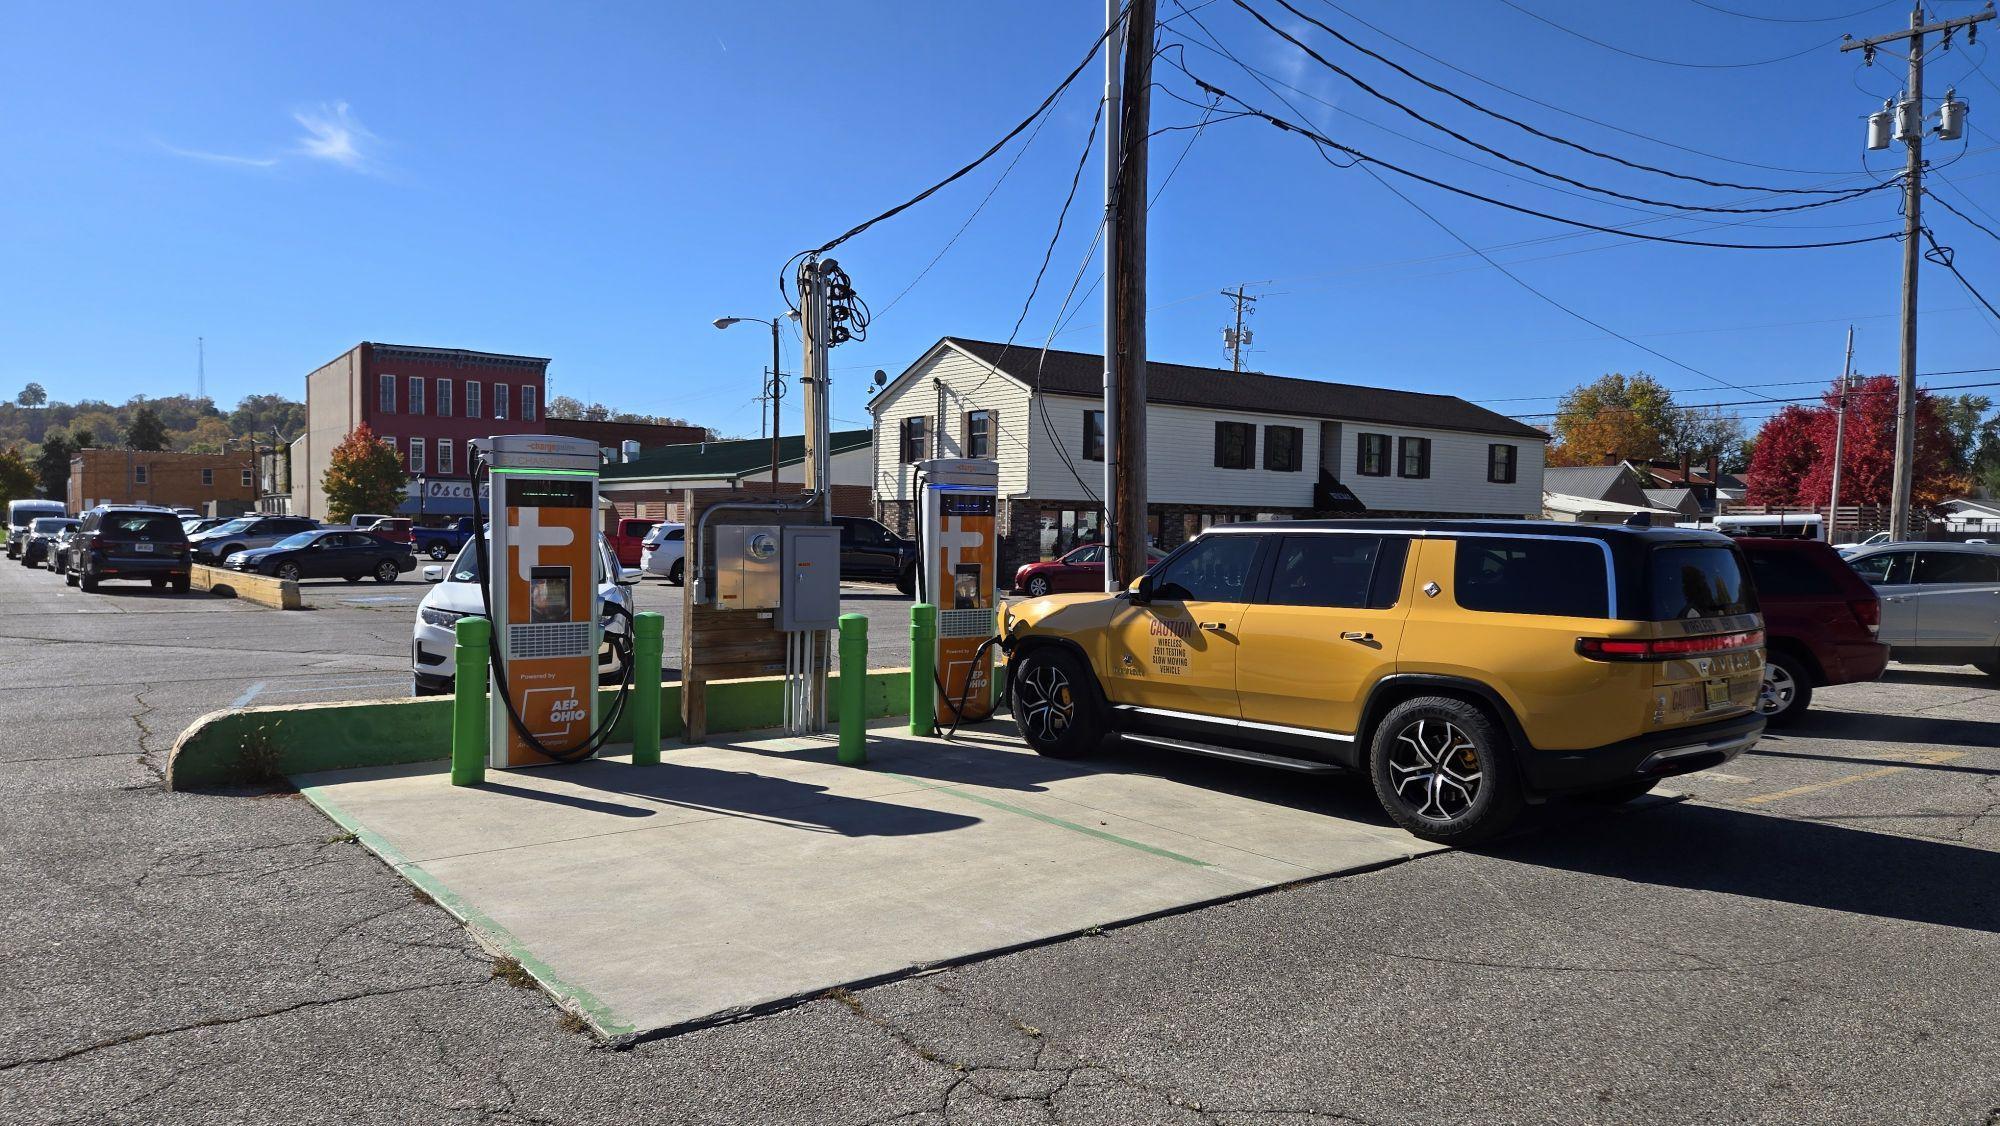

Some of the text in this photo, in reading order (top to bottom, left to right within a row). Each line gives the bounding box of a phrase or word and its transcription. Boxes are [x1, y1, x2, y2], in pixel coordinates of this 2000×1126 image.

[1150, 620, 1192, 638] CAUTION
[1158, 638, 1182, 648] WIRELESS
[1154, 647, 1186, 658] E911 TESTING
[1152, 655, 1188, 667] SLOW MOVING
[1699, 653, 1751, 674] RIVIAN
[1160, 665, 1181, 675] VEHICLE
[552, 700, 579, 711] AEP
[550, 710, 586, 722] OHIO
